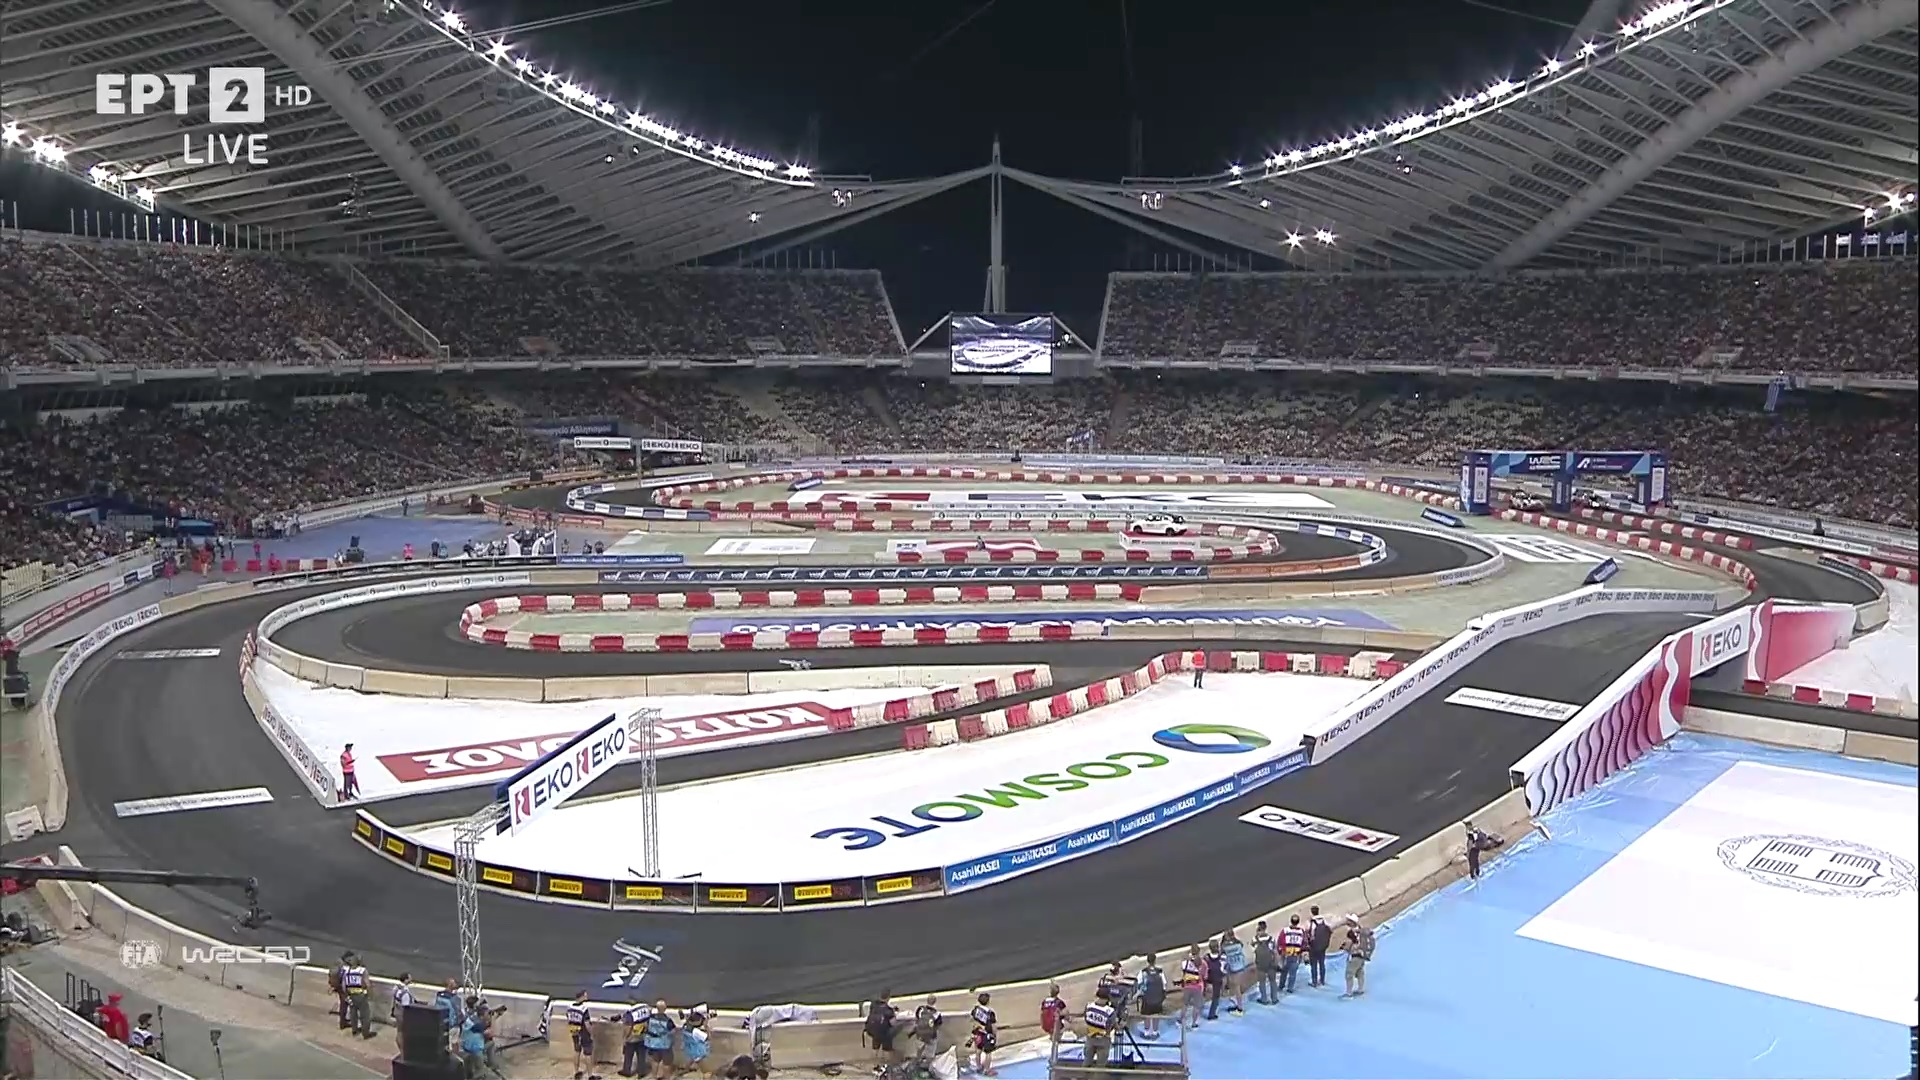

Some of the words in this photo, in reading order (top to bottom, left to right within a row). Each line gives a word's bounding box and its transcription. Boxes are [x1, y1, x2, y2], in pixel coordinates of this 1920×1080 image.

[1711, 623, 1742, 656] EKO
[534, 761, 573, 808] EKO
[591, 727, 625, 768] EKO
